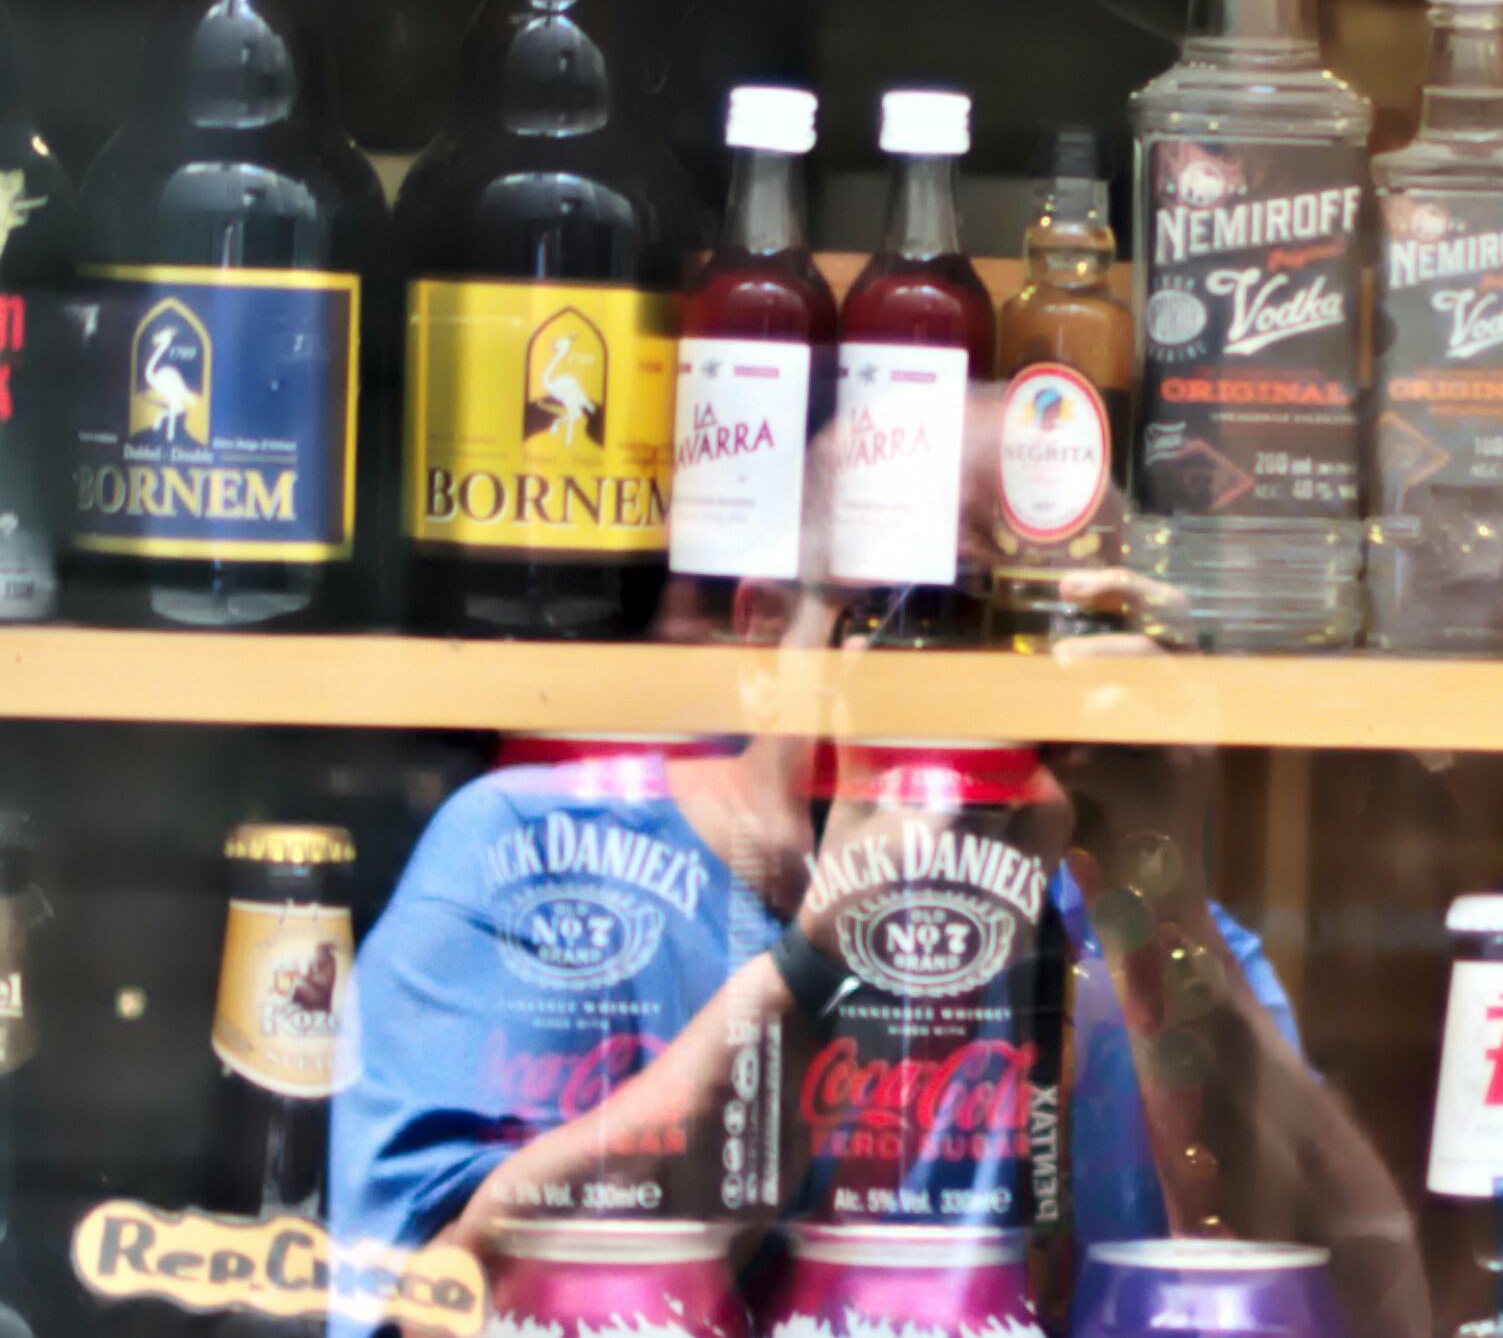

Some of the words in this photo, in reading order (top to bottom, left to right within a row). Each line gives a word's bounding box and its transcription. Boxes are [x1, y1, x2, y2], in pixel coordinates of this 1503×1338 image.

[1154, 185, 1362, 264] NEMIROFF
[1205, 267, 1344, 345] Vodka
[693, 402, 717, 433] LA
[1159, 376, 1351, 406] ORIGINAL
[672, 420, 775, 473] AVARRA
[1002, 443, 1095, 466] NEGRITA
[73, 464, 298, 522] BORNEM
[545, 811, 709, 920] DANIEL'S
[803, 836, 890, 913] JACK
[901, 818, 1047, 926] DANIEL'S
[586, 916, 613, 951] 7
[943, 920, 970, 956] 7
